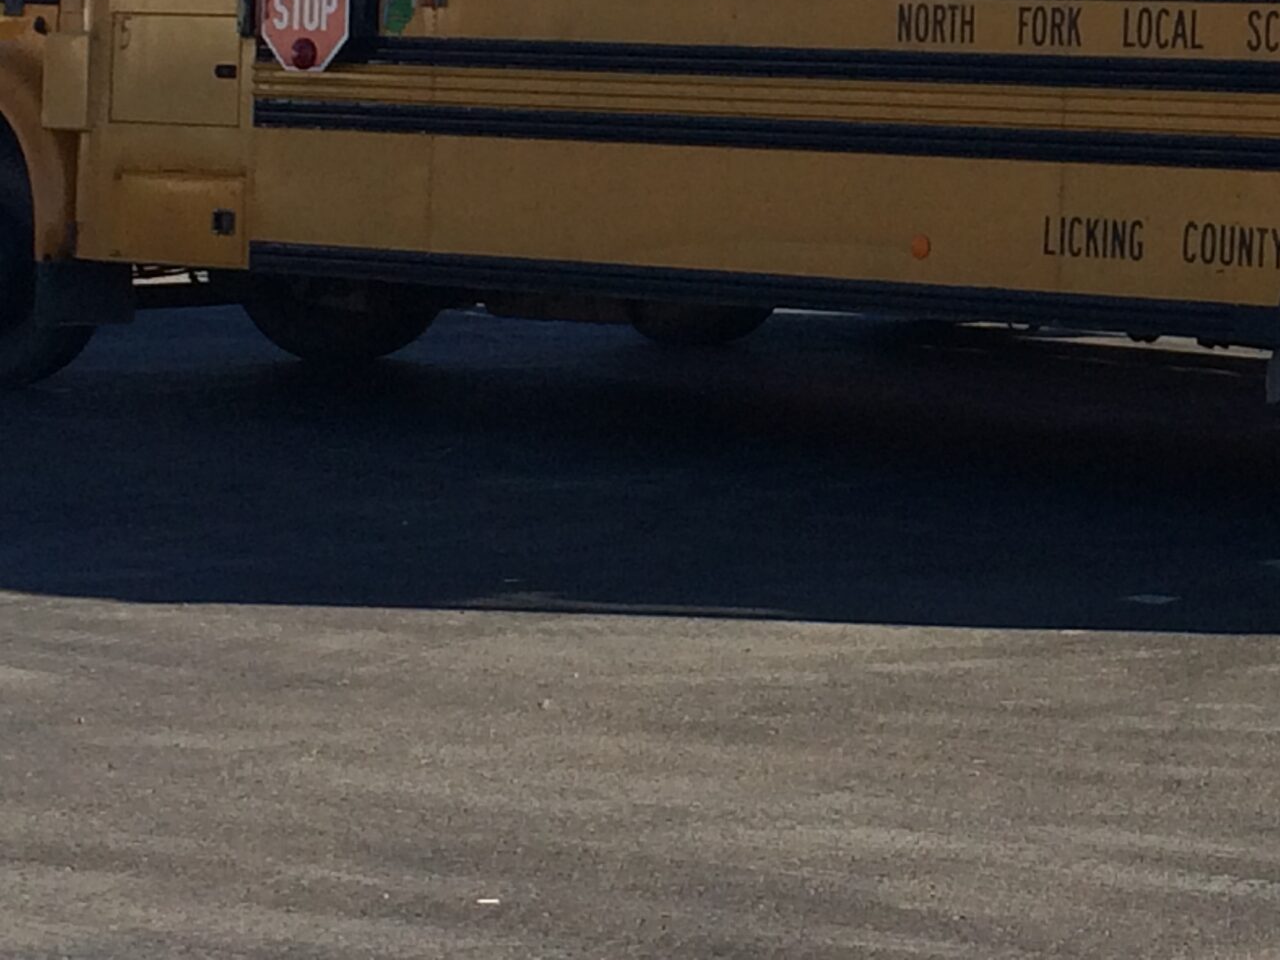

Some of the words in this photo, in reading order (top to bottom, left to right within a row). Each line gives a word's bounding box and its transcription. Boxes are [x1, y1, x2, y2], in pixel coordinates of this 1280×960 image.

[897, 3, 976, 44] NORTH
[1018, 6, 1082, 47] FORK
[1122, 7, 1204, 50] LOCAL
[1043, 216, 1144, 261] LICKING
